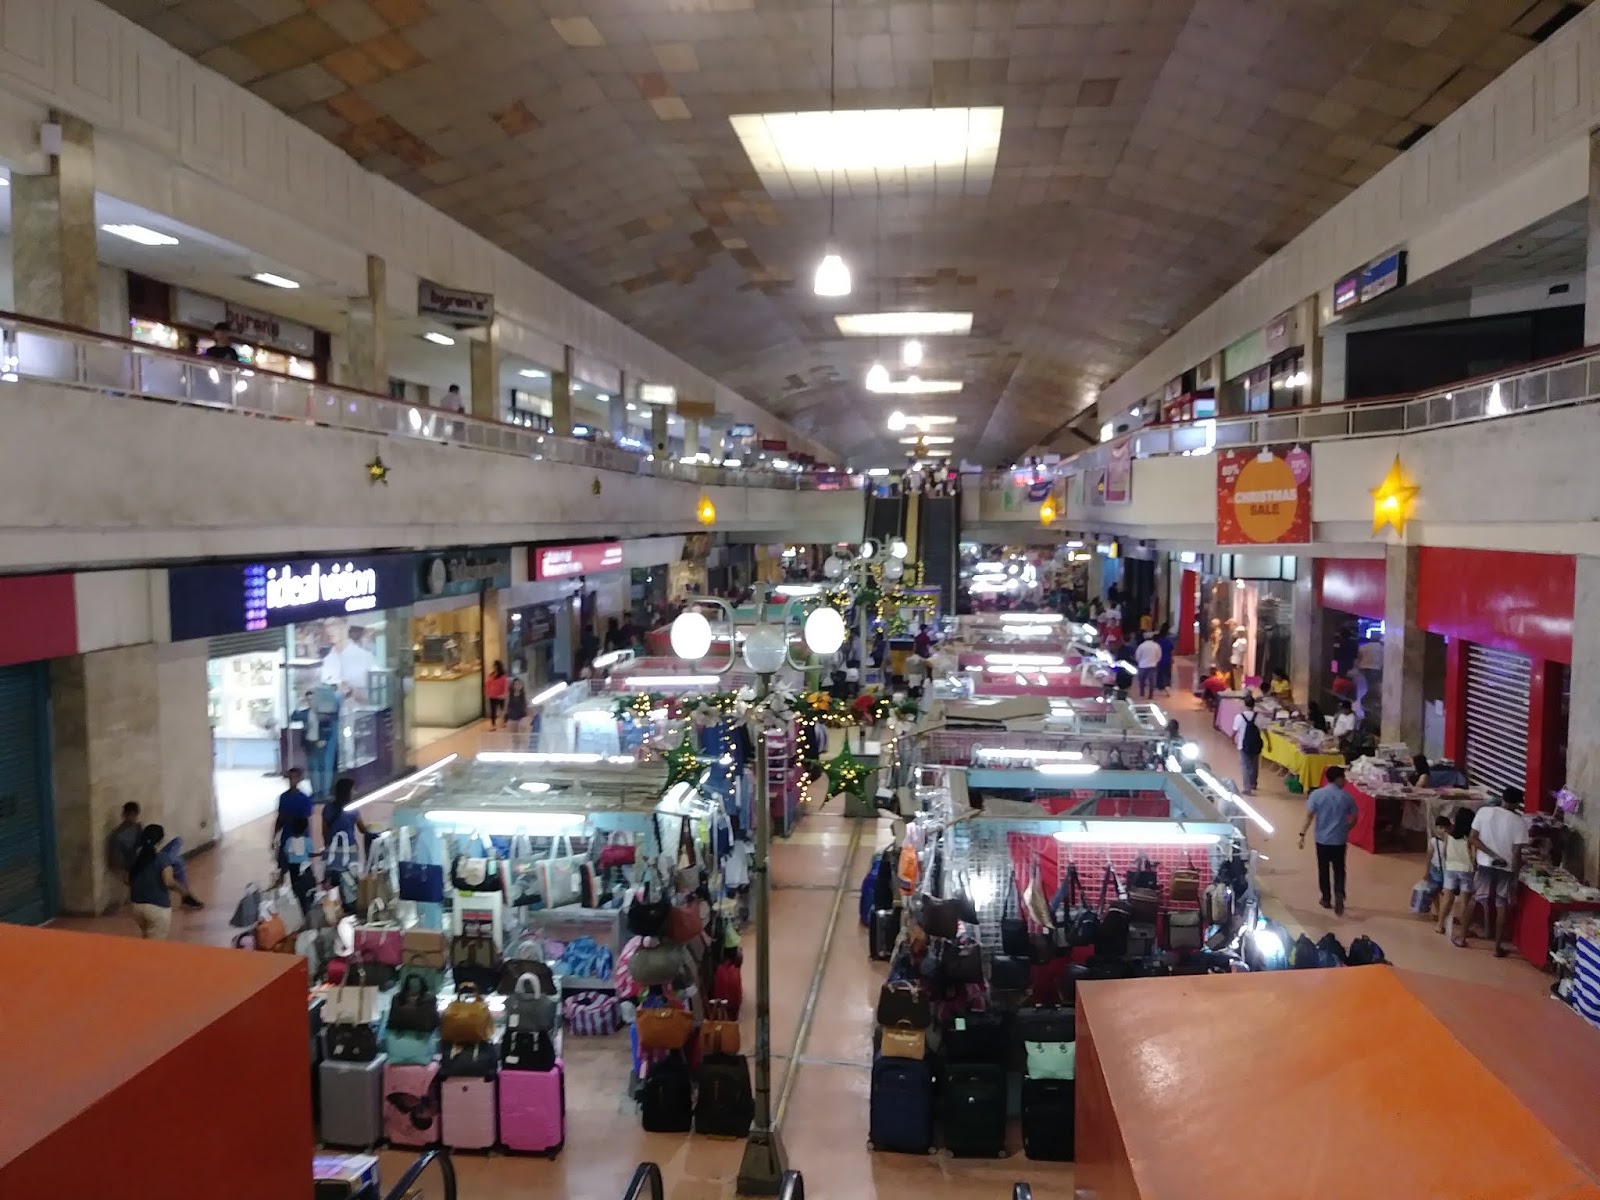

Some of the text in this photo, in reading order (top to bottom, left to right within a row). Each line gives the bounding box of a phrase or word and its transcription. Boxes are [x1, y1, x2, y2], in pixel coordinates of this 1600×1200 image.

[1250, 503, 1280, 516] SALE
[266, 561, 376, 609] ideal vision
